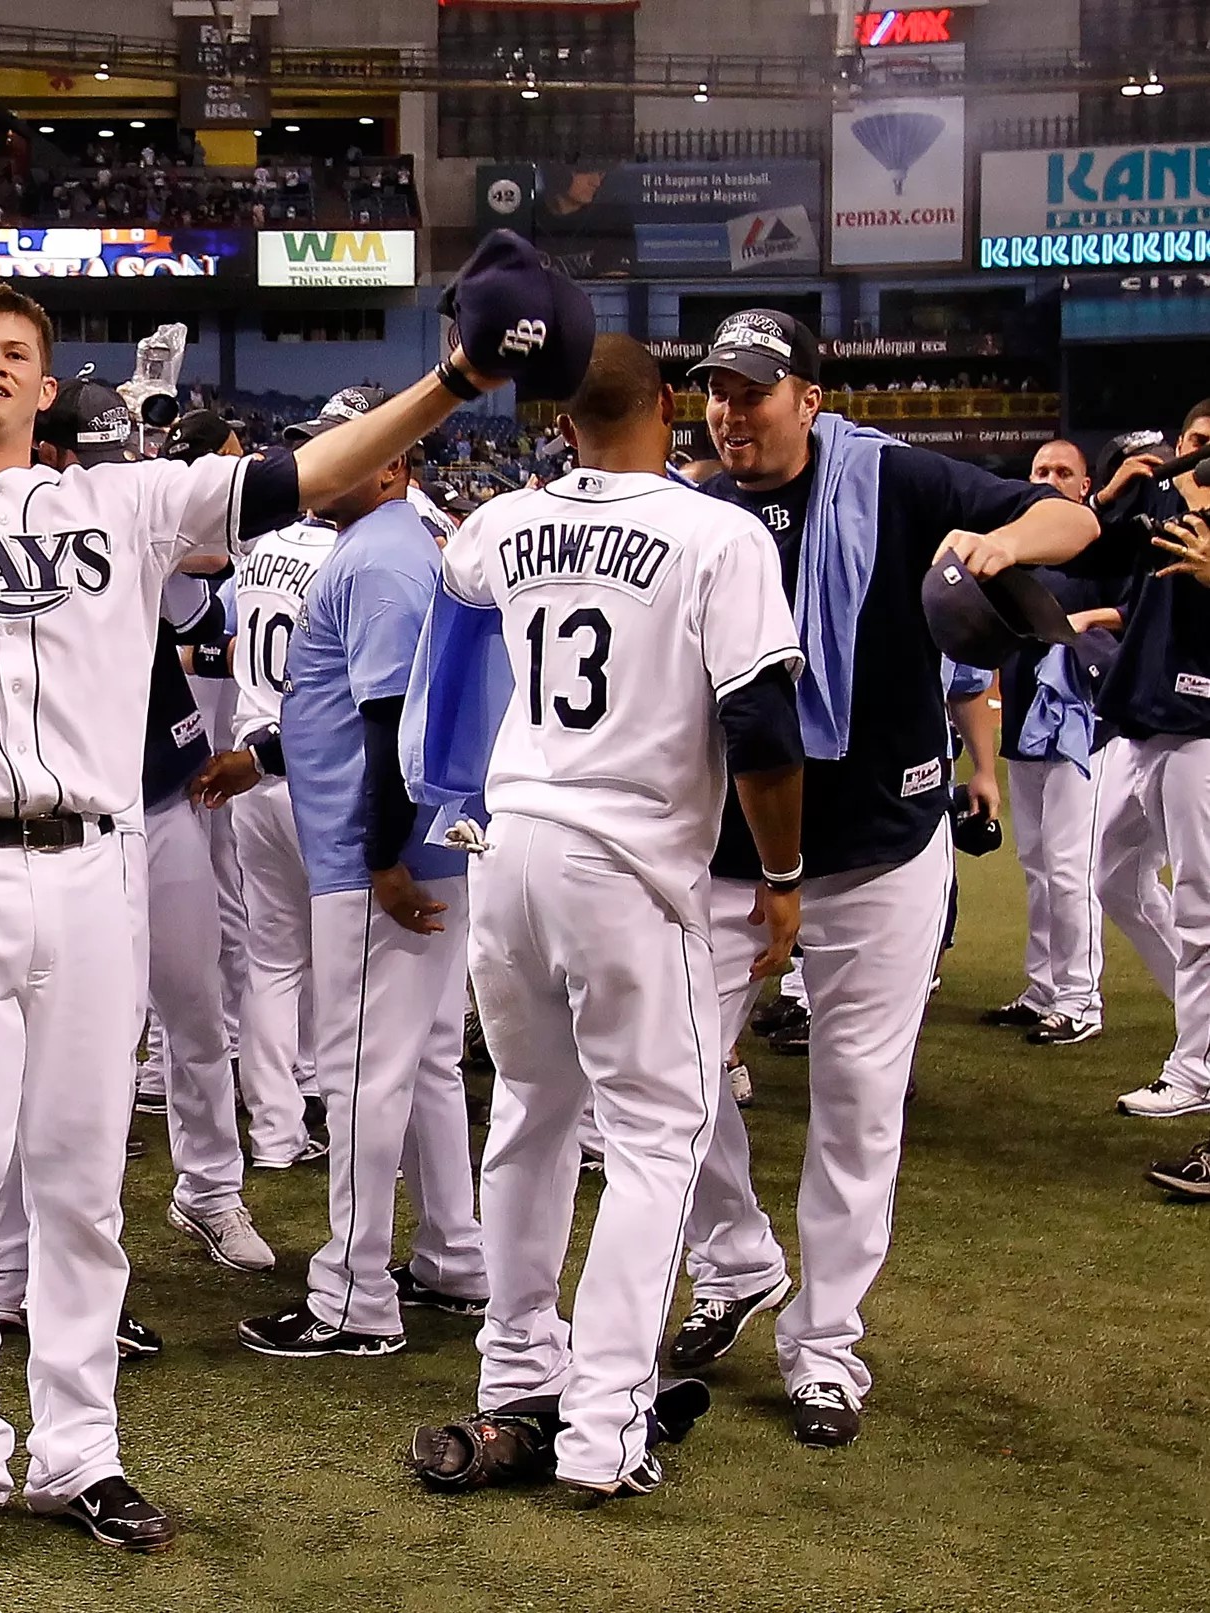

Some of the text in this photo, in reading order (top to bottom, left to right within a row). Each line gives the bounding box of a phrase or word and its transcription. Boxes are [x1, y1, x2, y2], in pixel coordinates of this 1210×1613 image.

[835, 207, 956, 227] remax.com
[283, 232, 387, 262] WM
[290, 275, 333, 286] Think
[497, 318, 547, 358] TB
[761, 504, 791, 531] TB
[498, 523, 670, 590] CRAWFORD
[248, 607, 295, 694] 10
[526, 606, 612, 730] 13
